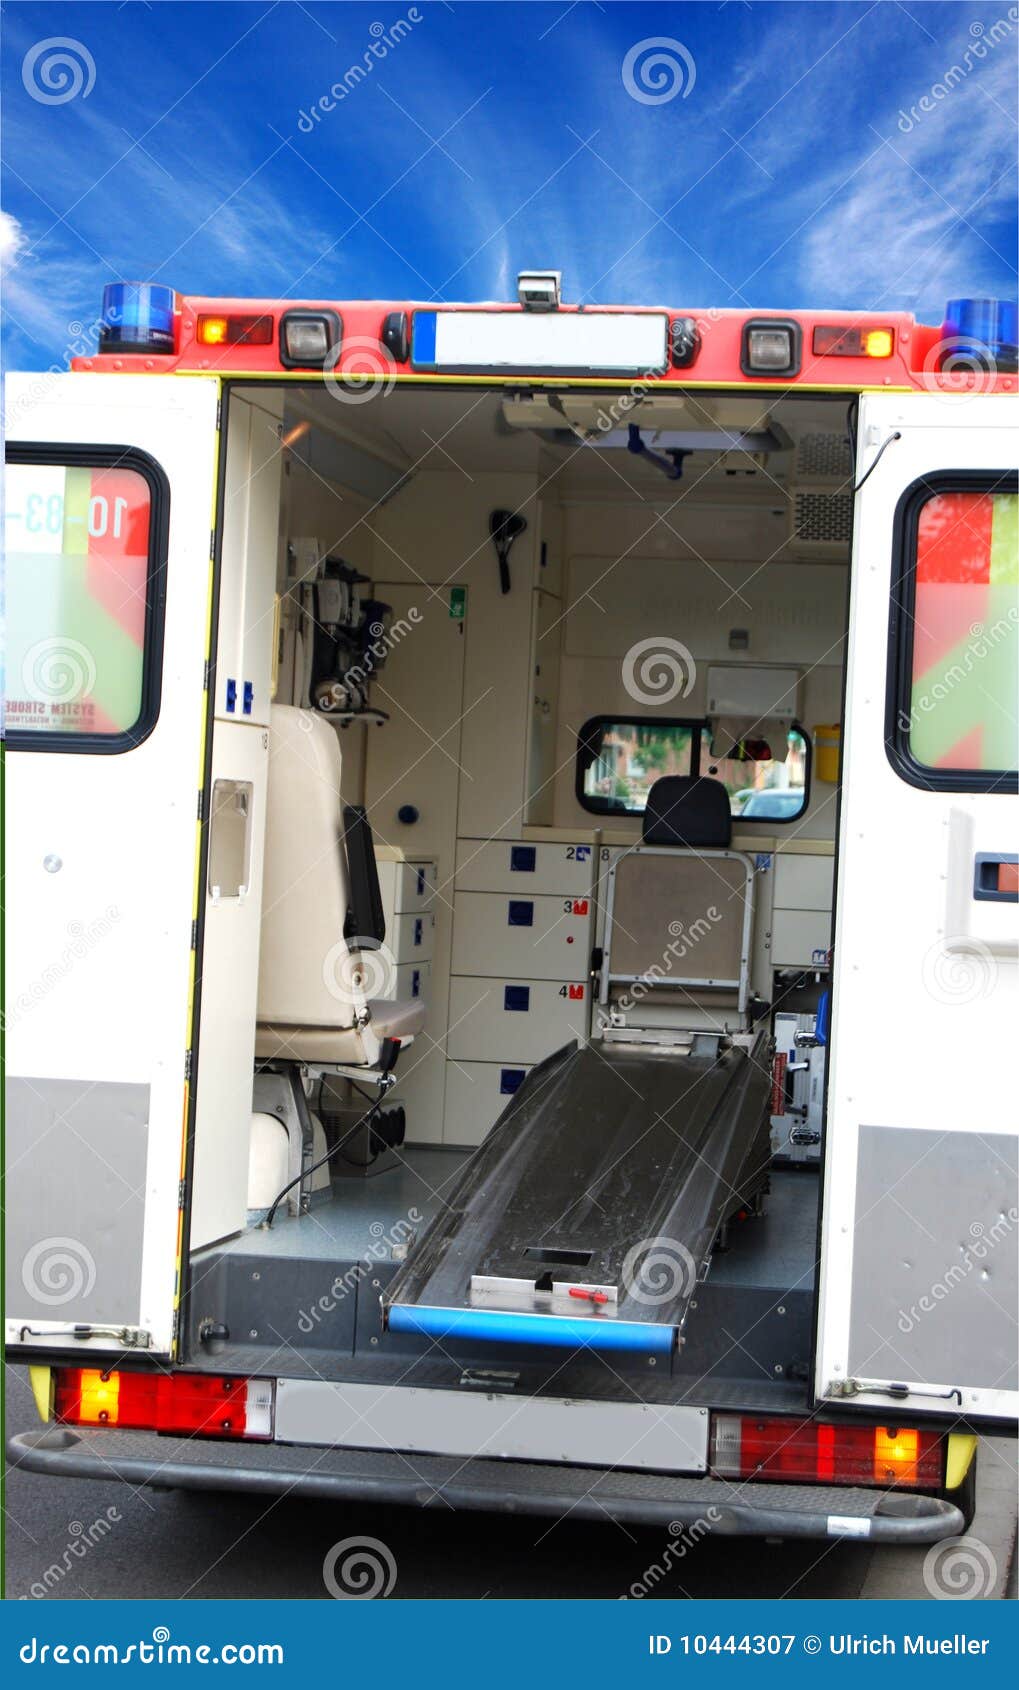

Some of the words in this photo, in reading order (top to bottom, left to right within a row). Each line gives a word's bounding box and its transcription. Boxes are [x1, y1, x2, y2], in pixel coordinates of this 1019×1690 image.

[566, 846, 575, 860] 2
[601, 848, 610, 861] 8
[563, 900, 572, 913] 3
[558, 985, 568, 998] 4
